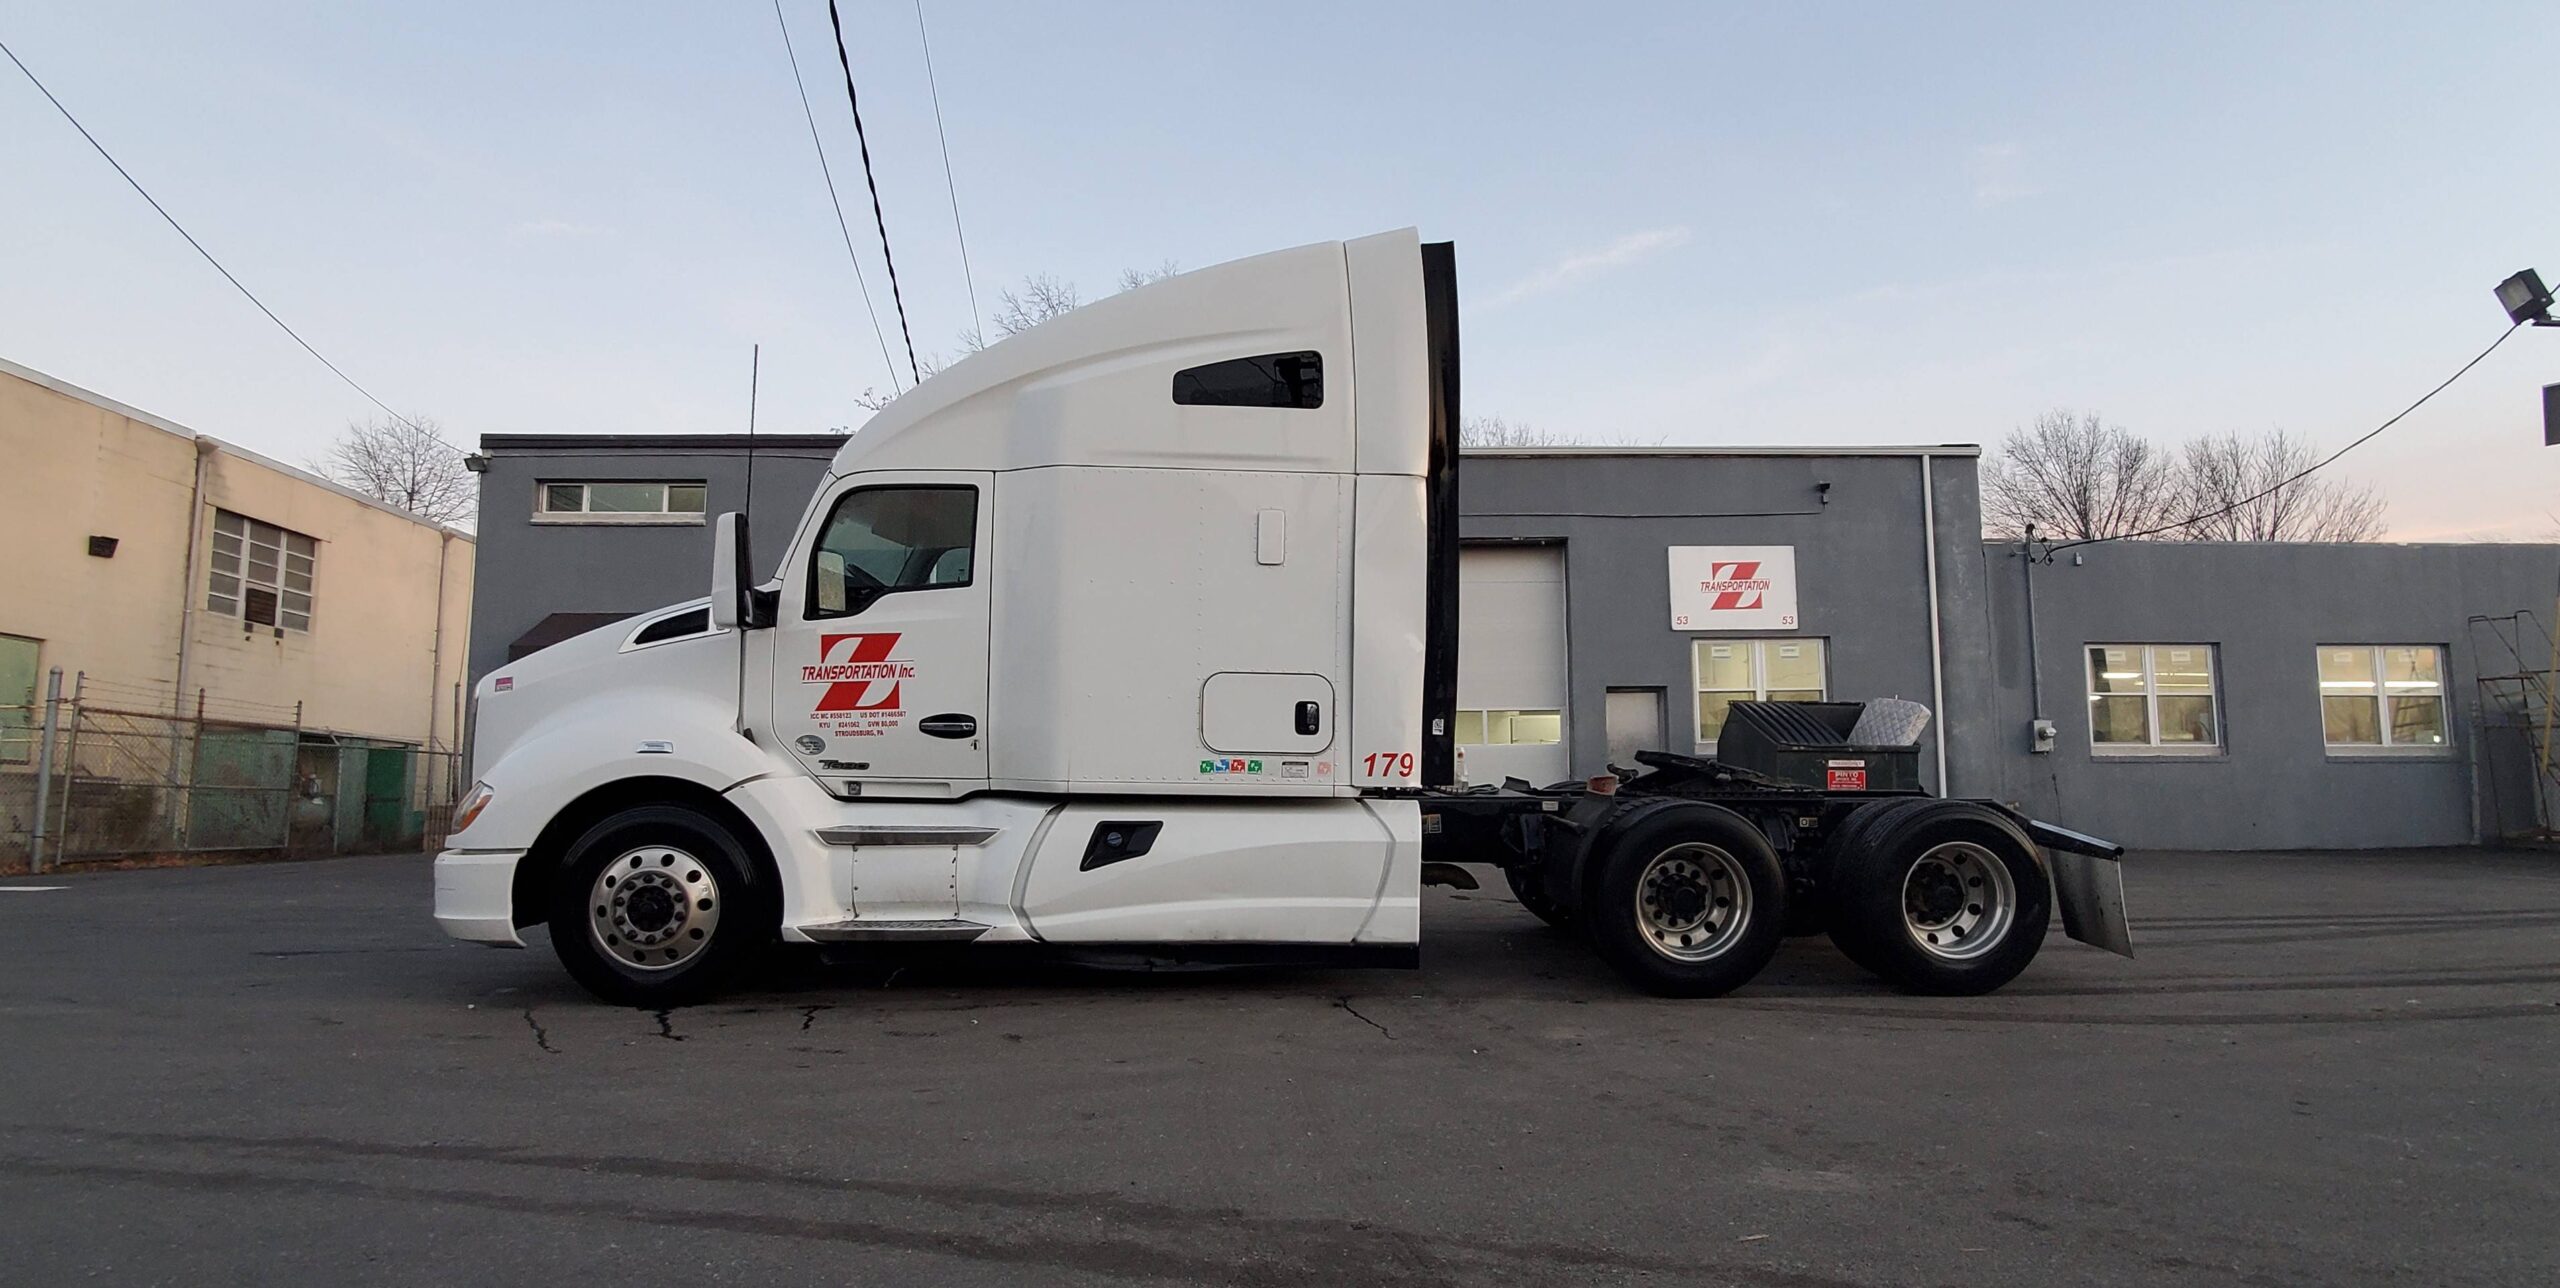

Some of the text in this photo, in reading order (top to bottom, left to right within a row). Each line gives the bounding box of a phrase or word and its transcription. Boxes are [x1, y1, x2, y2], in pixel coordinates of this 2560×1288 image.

[1700, 580, 1770, 592] TRANSPORTATION
[1676, 616, 1689, 625] 53
[1781, 616, 1794, 625] 53
[801, 664, 916, 680] TRANSPORTATION Inc.
[1364, 752, 1414, 778] 179
